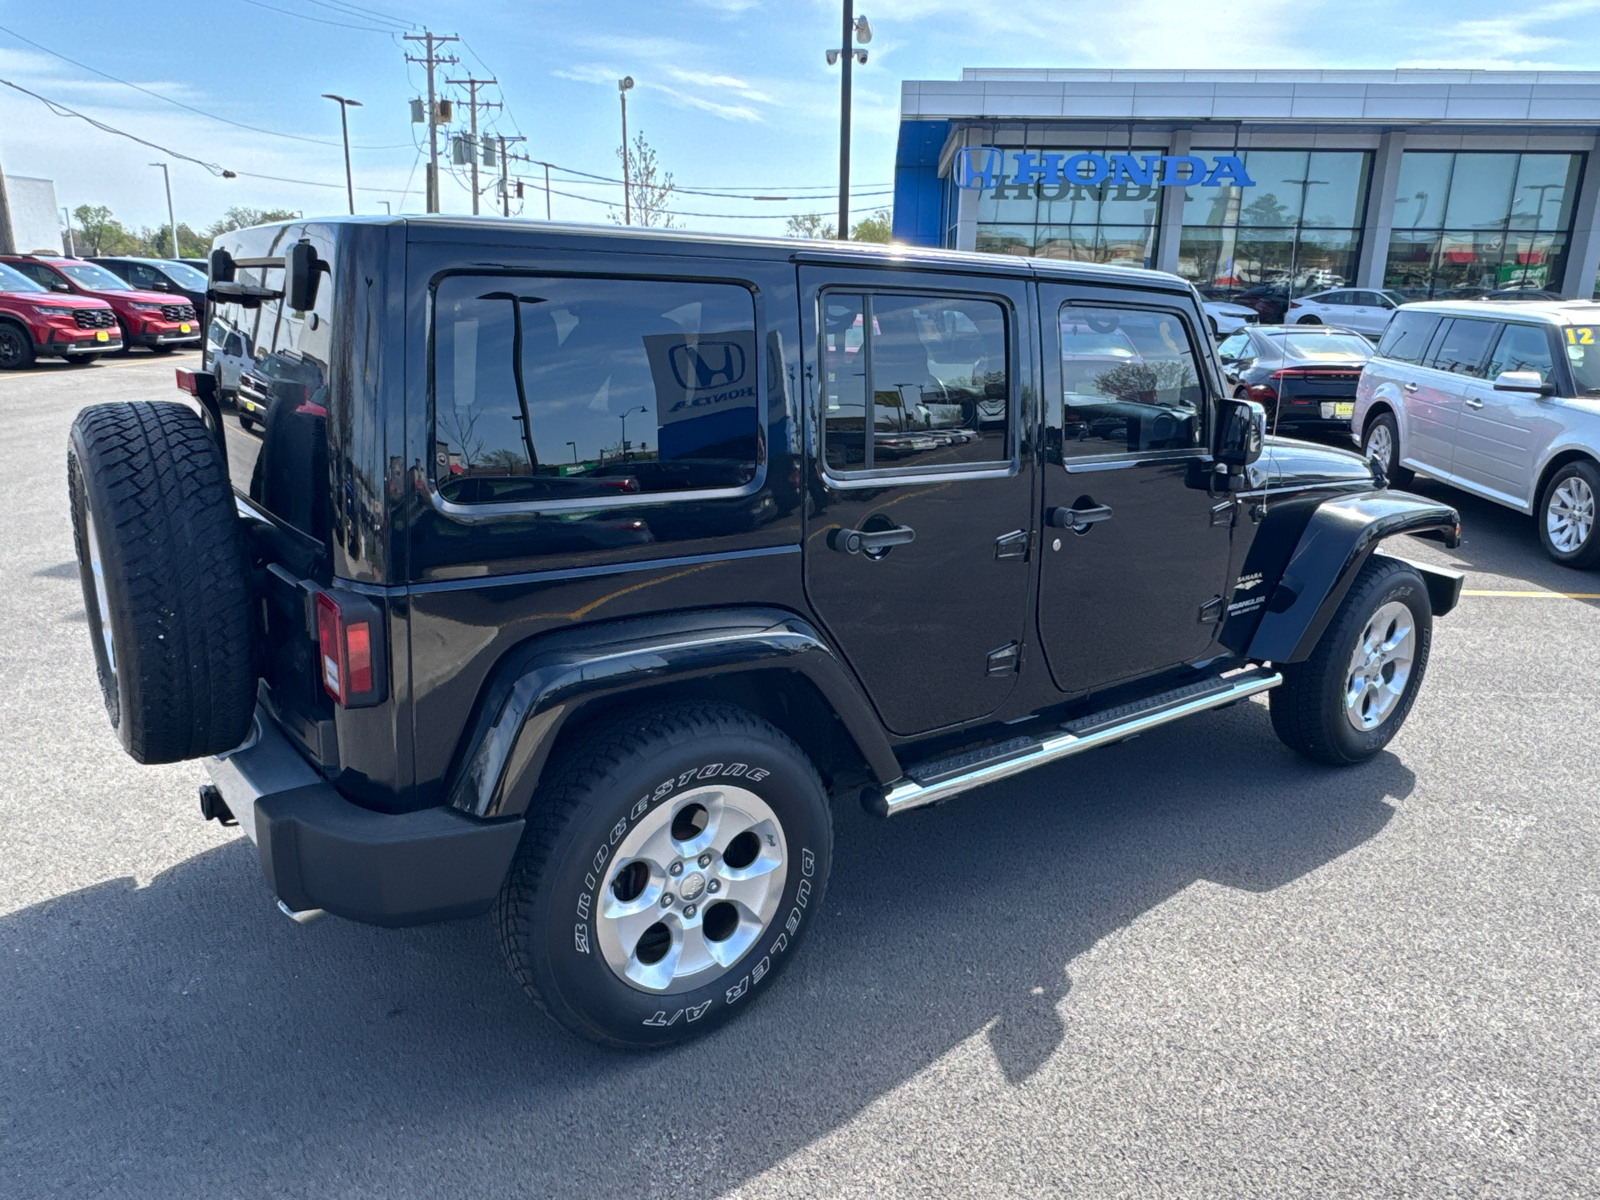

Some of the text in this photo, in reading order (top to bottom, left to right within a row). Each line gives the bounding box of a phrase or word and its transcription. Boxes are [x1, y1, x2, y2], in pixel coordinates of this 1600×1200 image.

[1012, 153, 1256, 187] HONDA
[1565, 327, 1595, 345] 12
[574, 762, 771, 955] BRIDGESTONE
[642, 848, 815, 1027] DUELER A/T
